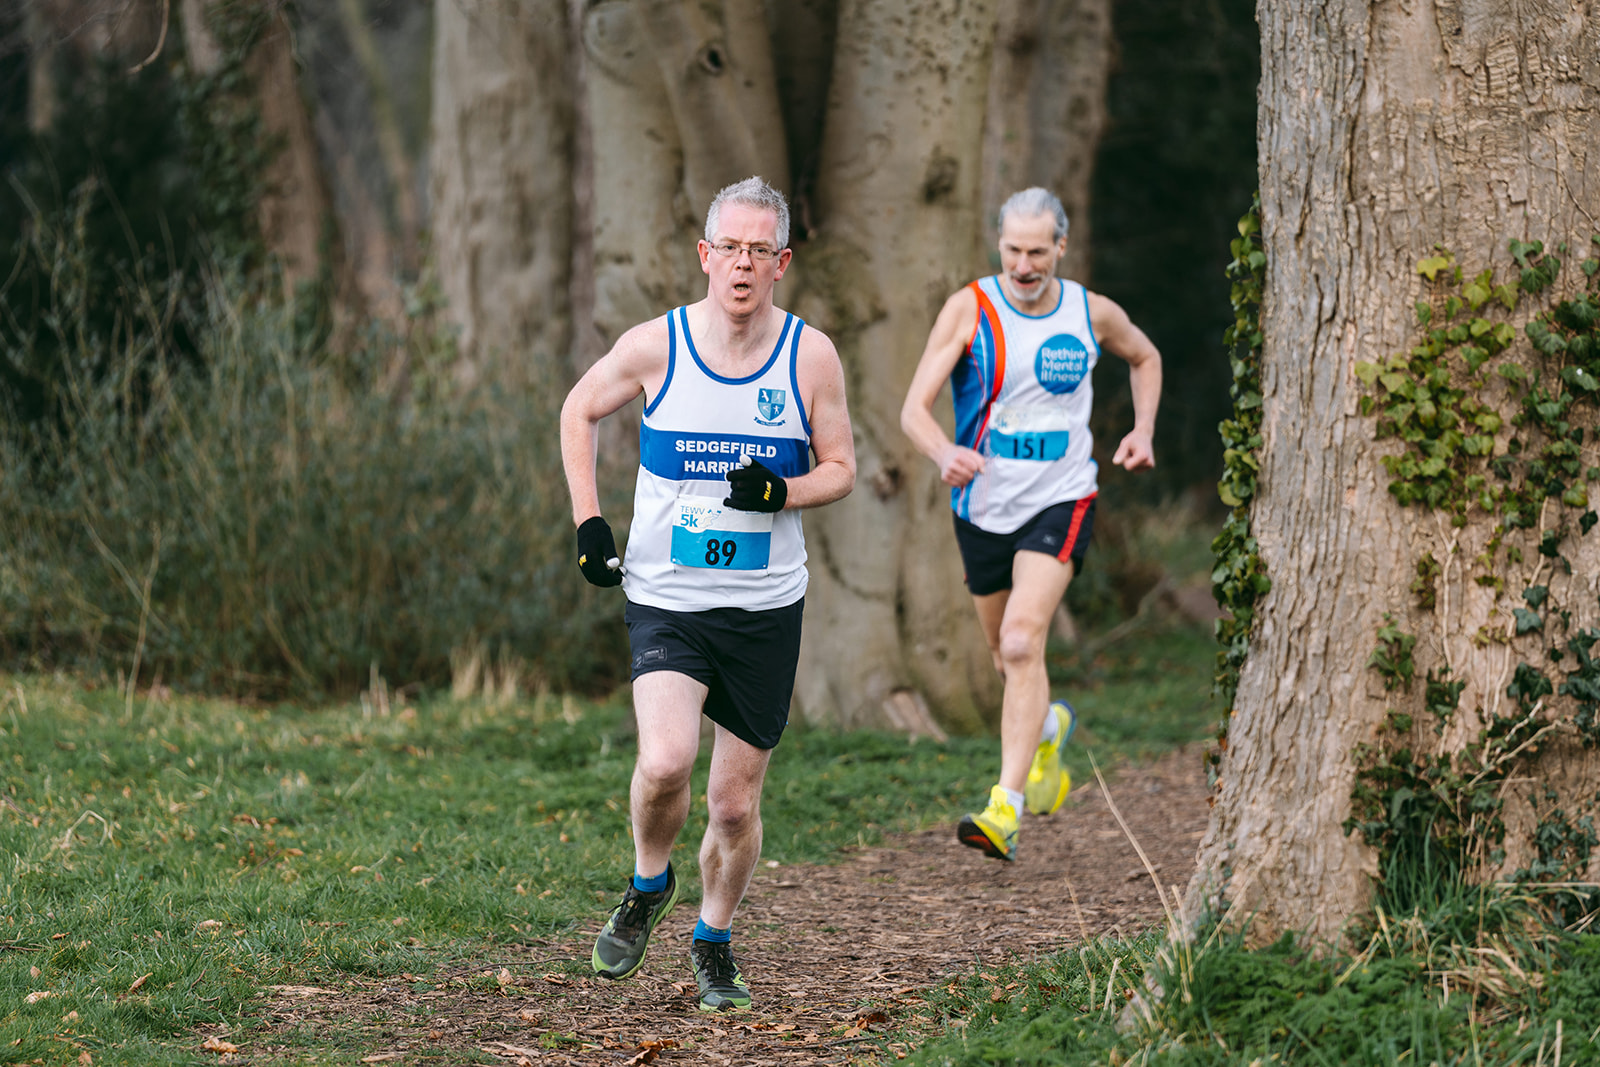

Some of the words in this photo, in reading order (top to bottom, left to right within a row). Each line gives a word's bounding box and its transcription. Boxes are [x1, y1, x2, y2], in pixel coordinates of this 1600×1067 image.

[1041, 359, 1083, 371] Mental
[675, 439, 777, 458] SEDGEFIELD
[1013, 438, 1044, 459] 151
[680, 505, 705, 515] TEWV
[680, 514, 699, 528] 5k
[704, 538, 737, 567] 89
